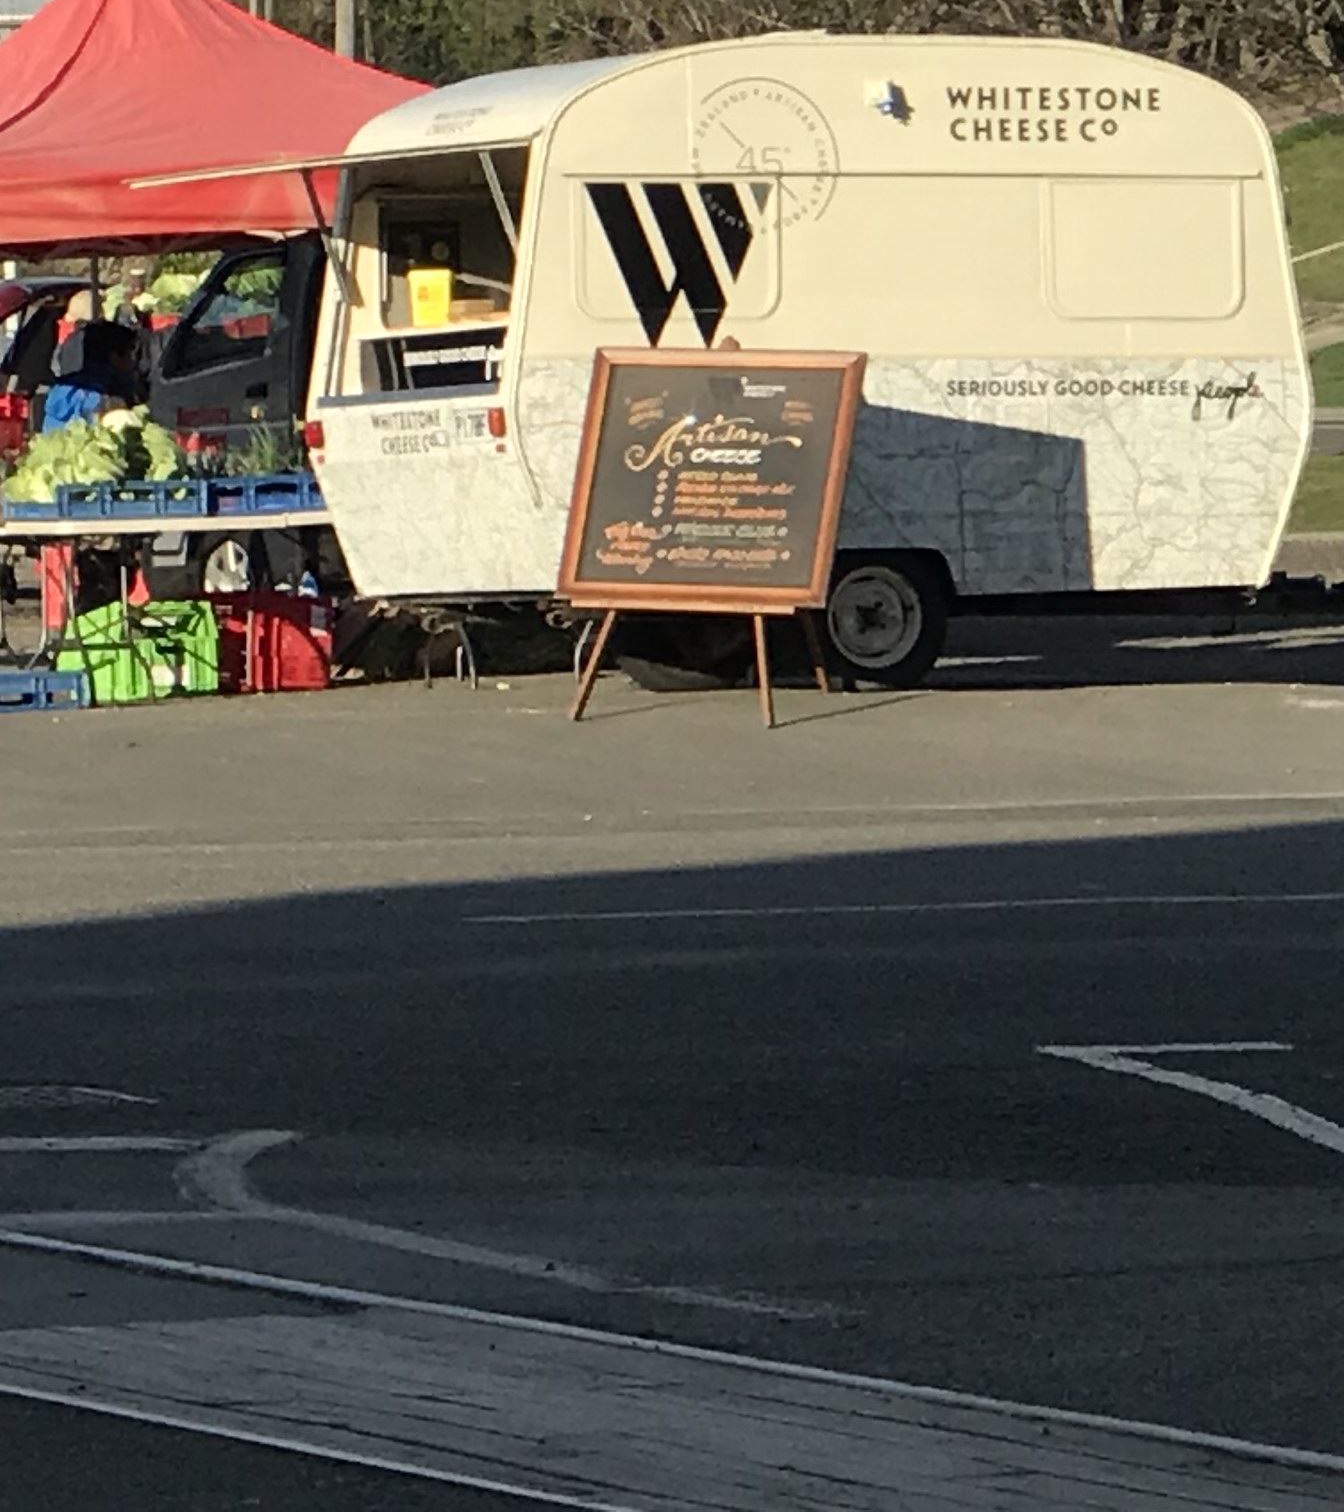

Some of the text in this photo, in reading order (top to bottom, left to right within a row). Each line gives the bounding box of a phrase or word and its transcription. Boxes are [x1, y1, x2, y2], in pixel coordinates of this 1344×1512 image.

[946, 86, 1161, 111] WHITESTONE
[949, 117, 1068, 142] CHEESE
[946, 379, 1047, 397] SERIOUSLY
[1054, 379, 1114, 397] GOOD
[1117, 379, 1190, 397] CHEESE
[624, 414, 803, 472] Artisan
